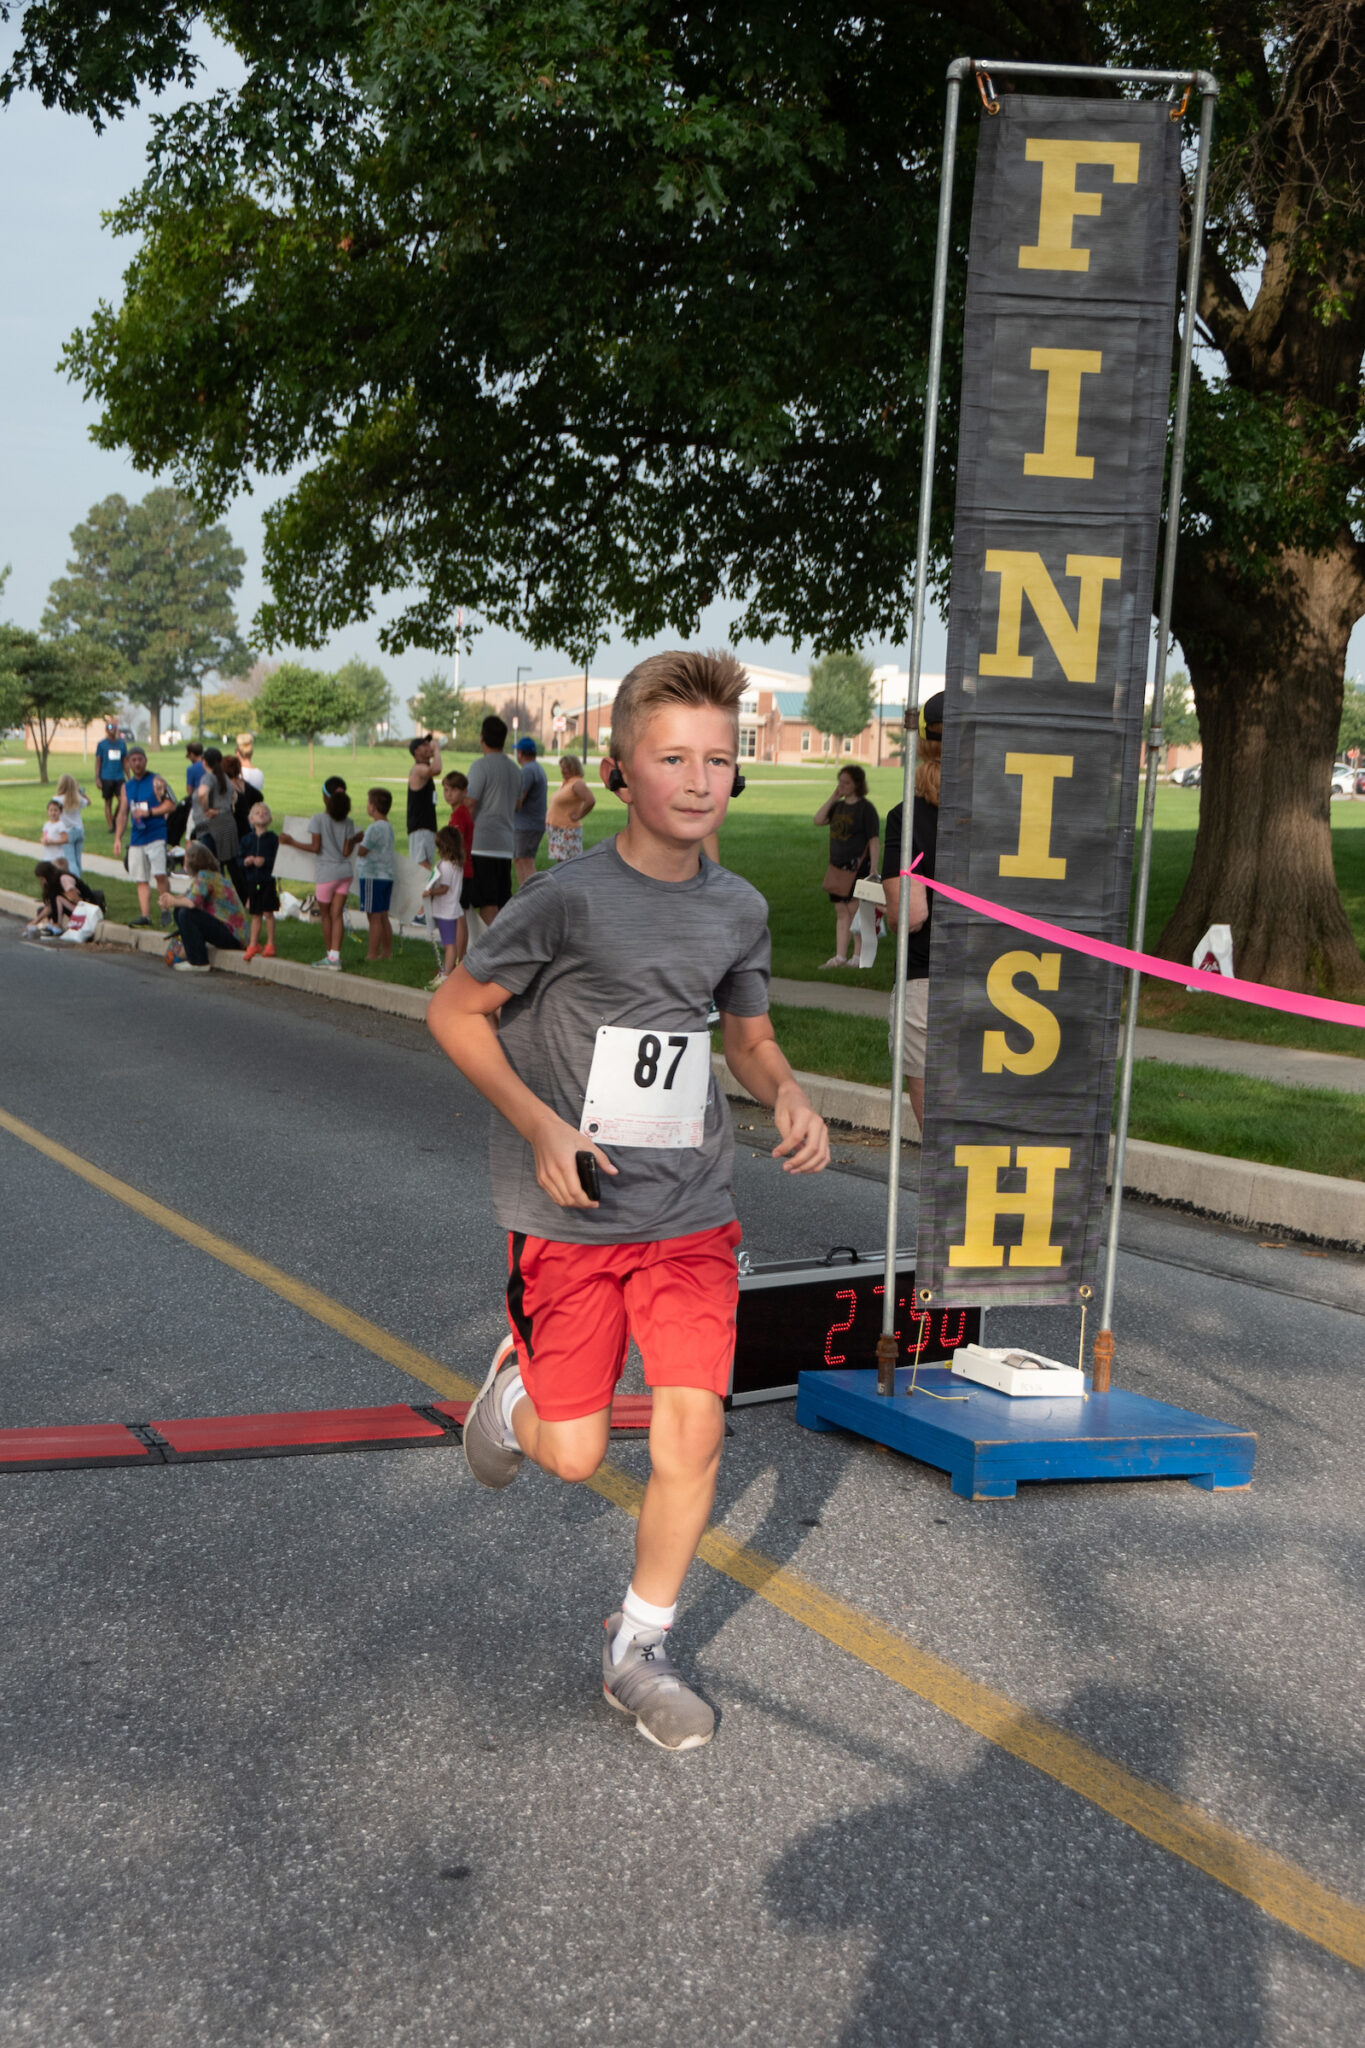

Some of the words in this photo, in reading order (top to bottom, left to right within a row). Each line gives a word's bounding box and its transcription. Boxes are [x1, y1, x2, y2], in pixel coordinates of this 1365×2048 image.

[948, 138, 1141, 1268] FINISH
[634, 1034, 688, 1090] 87
[824, 1285, 965, 1366] 2:50
